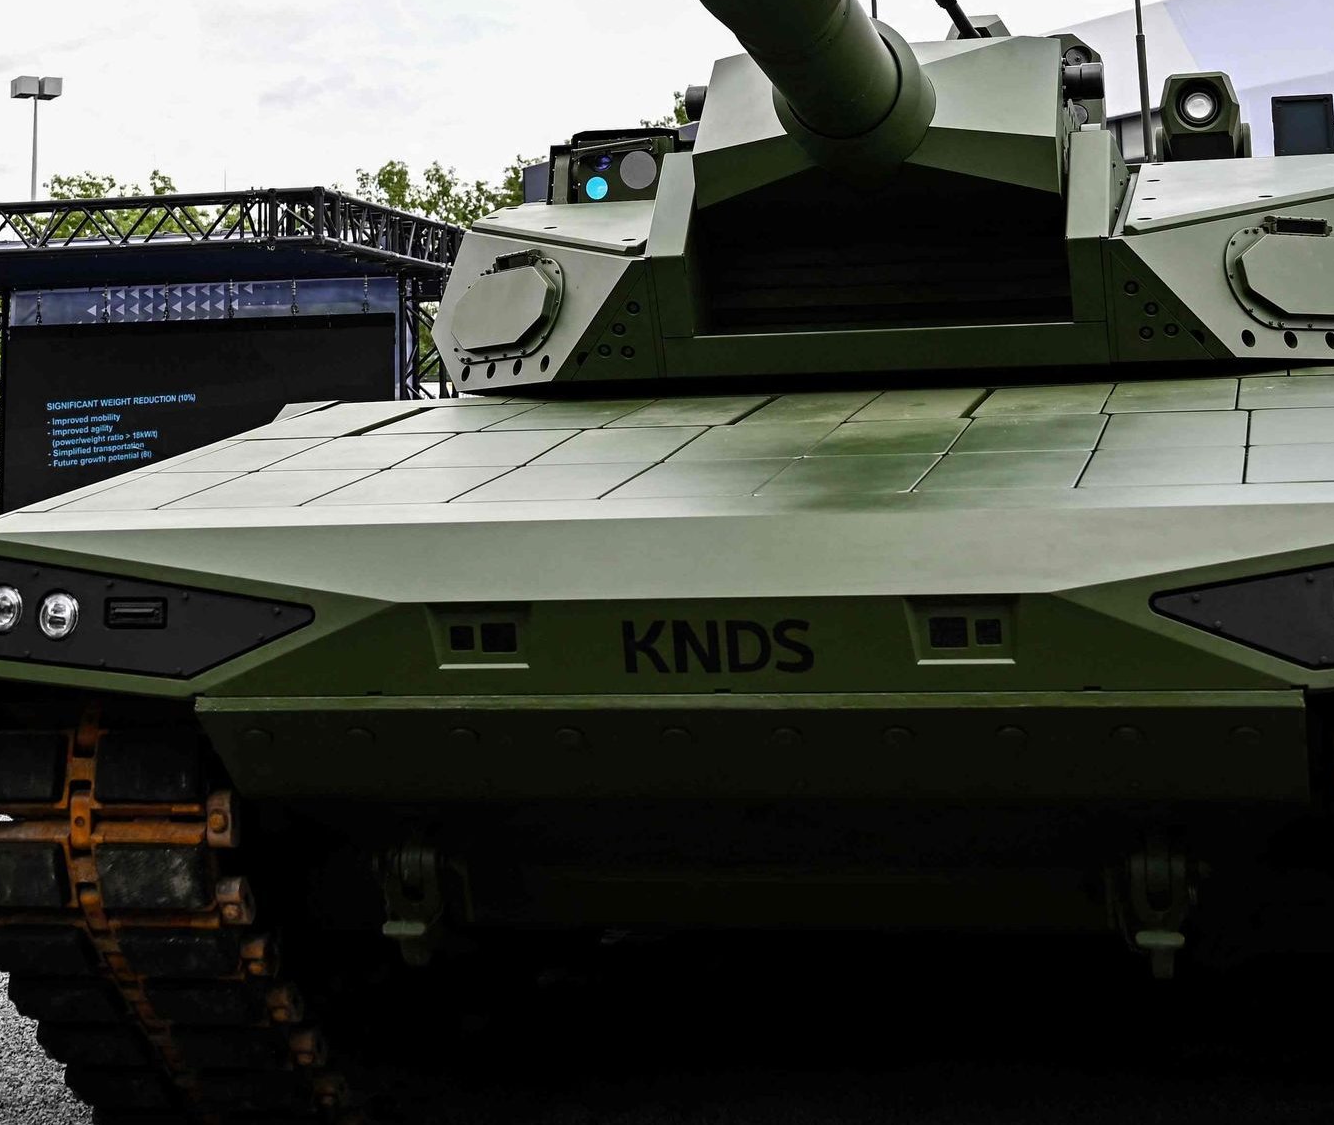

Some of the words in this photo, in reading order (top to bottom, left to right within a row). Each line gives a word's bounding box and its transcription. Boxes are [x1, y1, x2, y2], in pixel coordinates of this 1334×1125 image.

[47, 399, 99, 411] SIGNIFICANT
[99, 396, 132, 408] WEIGHT
[133, 394, 177, 405] REDUCTION
[178, 393, 196, 403] (10%)
[52, 415, 89, 426] Improved
[90, 413, 121, 423] mobility
[52, 426, 89, 437] Improved
[90, 424, 113, 435] agility
[52, 435, 106, 448] (power/weight
[107, 433, 124, 442] ratio
[53, 446, 92, 458] Simplified
[93, 442, 145, 456] transportation
[53, 458, 78, 468] Future
[80, 456, 106, 467] growth
[108, 452, 140, 464] potential
[621, 618, 815, 674] KNDS
